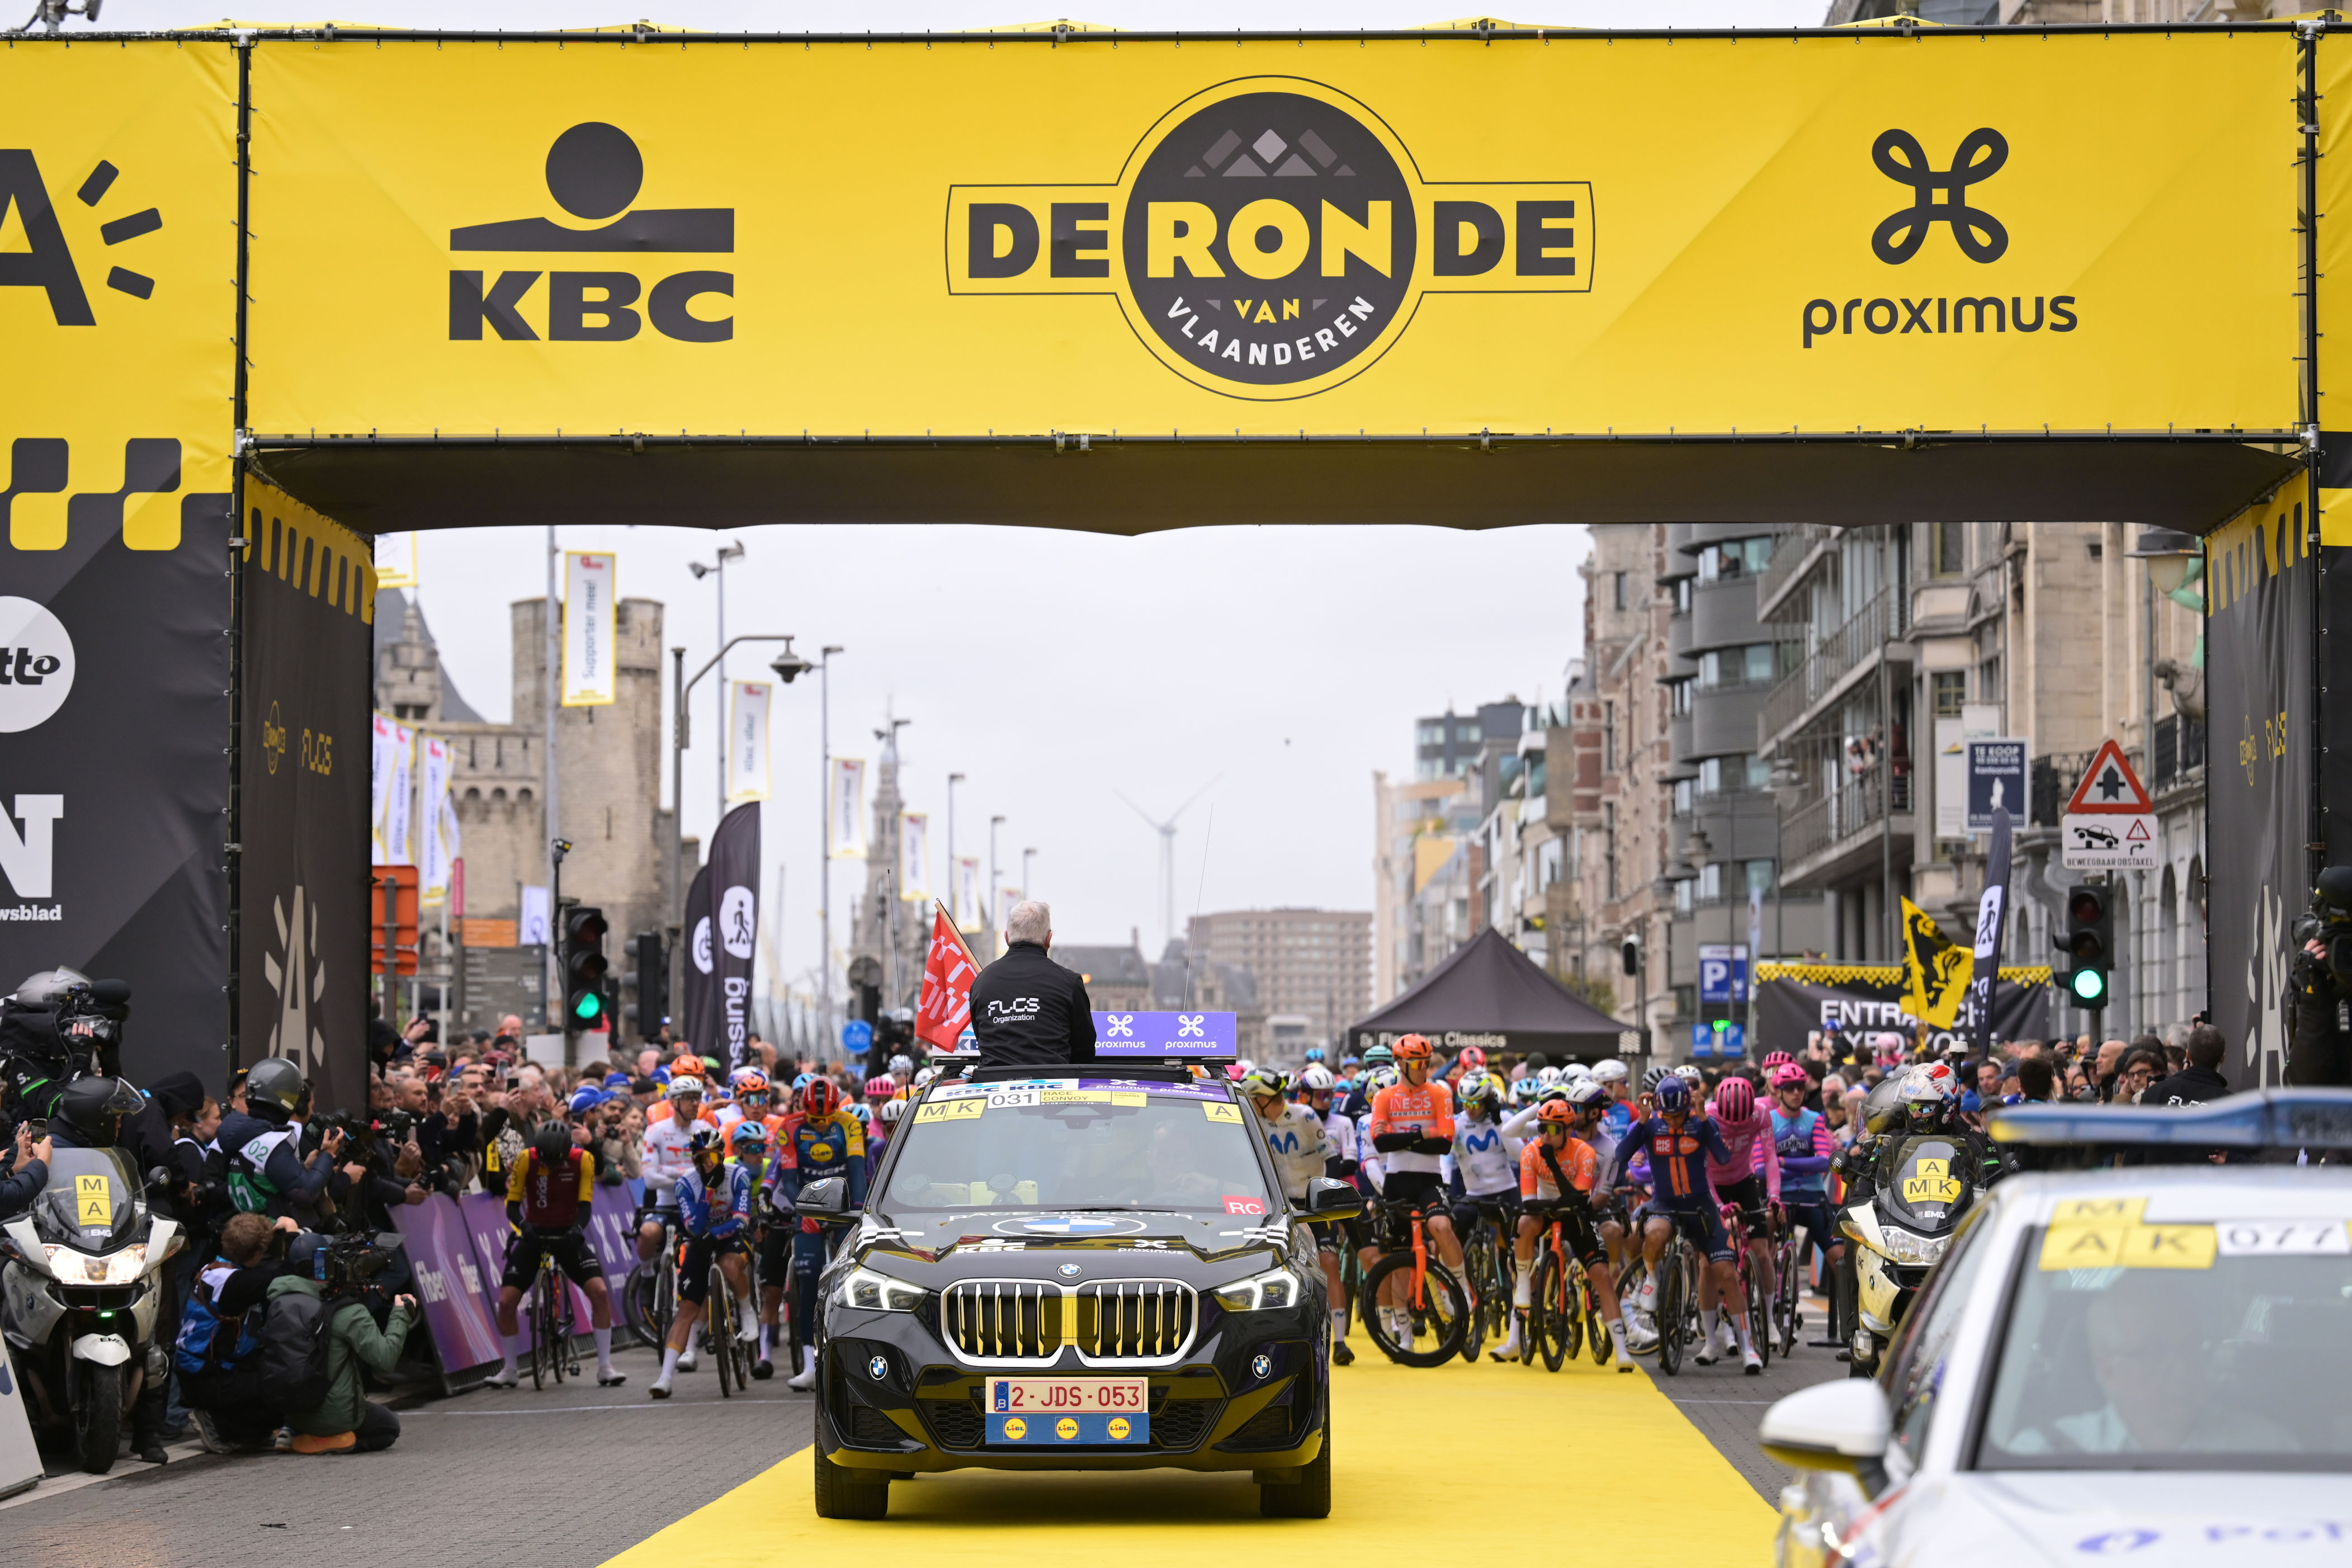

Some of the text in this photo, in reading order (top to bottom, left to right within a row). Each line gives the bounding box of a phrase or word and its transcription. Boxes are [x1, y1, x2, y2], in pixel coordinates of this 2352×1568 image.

[449, 270, 734, 343] KBC
[1233, 298, 1301, 323] VAN
[1802, 295, 2079, 349] proximus
[1166, 294, 1376, 366] VLAANDEREN
[1989, 745, 2020, 757] KOOP
[2067, 858, 2153, 866] BEWEEGBAAR OBSTAKEL
[1703, 961, 1727, 991] P
[993, 1014, 1035, 1024] Organization
[1094, 1041, 1146, 1050] proximus
[1165, 1041, 1217, 1050] proximus
[1444, 1031, 1507, 1048] Classics
[946, 1087, 1000, 1097] KBC
[1009, 1083, 1064, 1091] KBC
[1159, 1088, 1215, 1097] proximus
[991, 1093, 1033, 1106] 031
[1390, 1097, 1432, 1110] INEOS
[1444, 1088, 1454, 1120] NEOS
[923, 1105, 946, 1117] M
[957, 1102, 974, 1113] K
[1215, 1105, 1233, 1117] A
[248, 1140, 269, 1163] 02
[804, 1163, 847, 1176] TREK
[1538, 1164, 1576, 1178] INOS
[1924, 1161, 1940, 1173] A
[83, 1178, 102, 1191] M
[1909, 1179, 1927, 1194] M
[1939, 1180, 1953, 1195] K
[738, 1189, 749, 1212] BOSS
[87, 1202, 103, 1216] A
[678, 1197, 691, 1218] BOSS
[1228, 1202, 1262, 1215] RC
[2076, 1202, 2124, 1215] M
[949, 1211, 1194, 1221] RACE DIRECTOR
[91, 1230, 112, 1238] EMG
[2153, 1227, 2191, 1253] K
[2068, 1232, 2107, 1253] A
[955, 1245, 1026, 1254] KBC
[998, 1399, 1006, 1409] B
